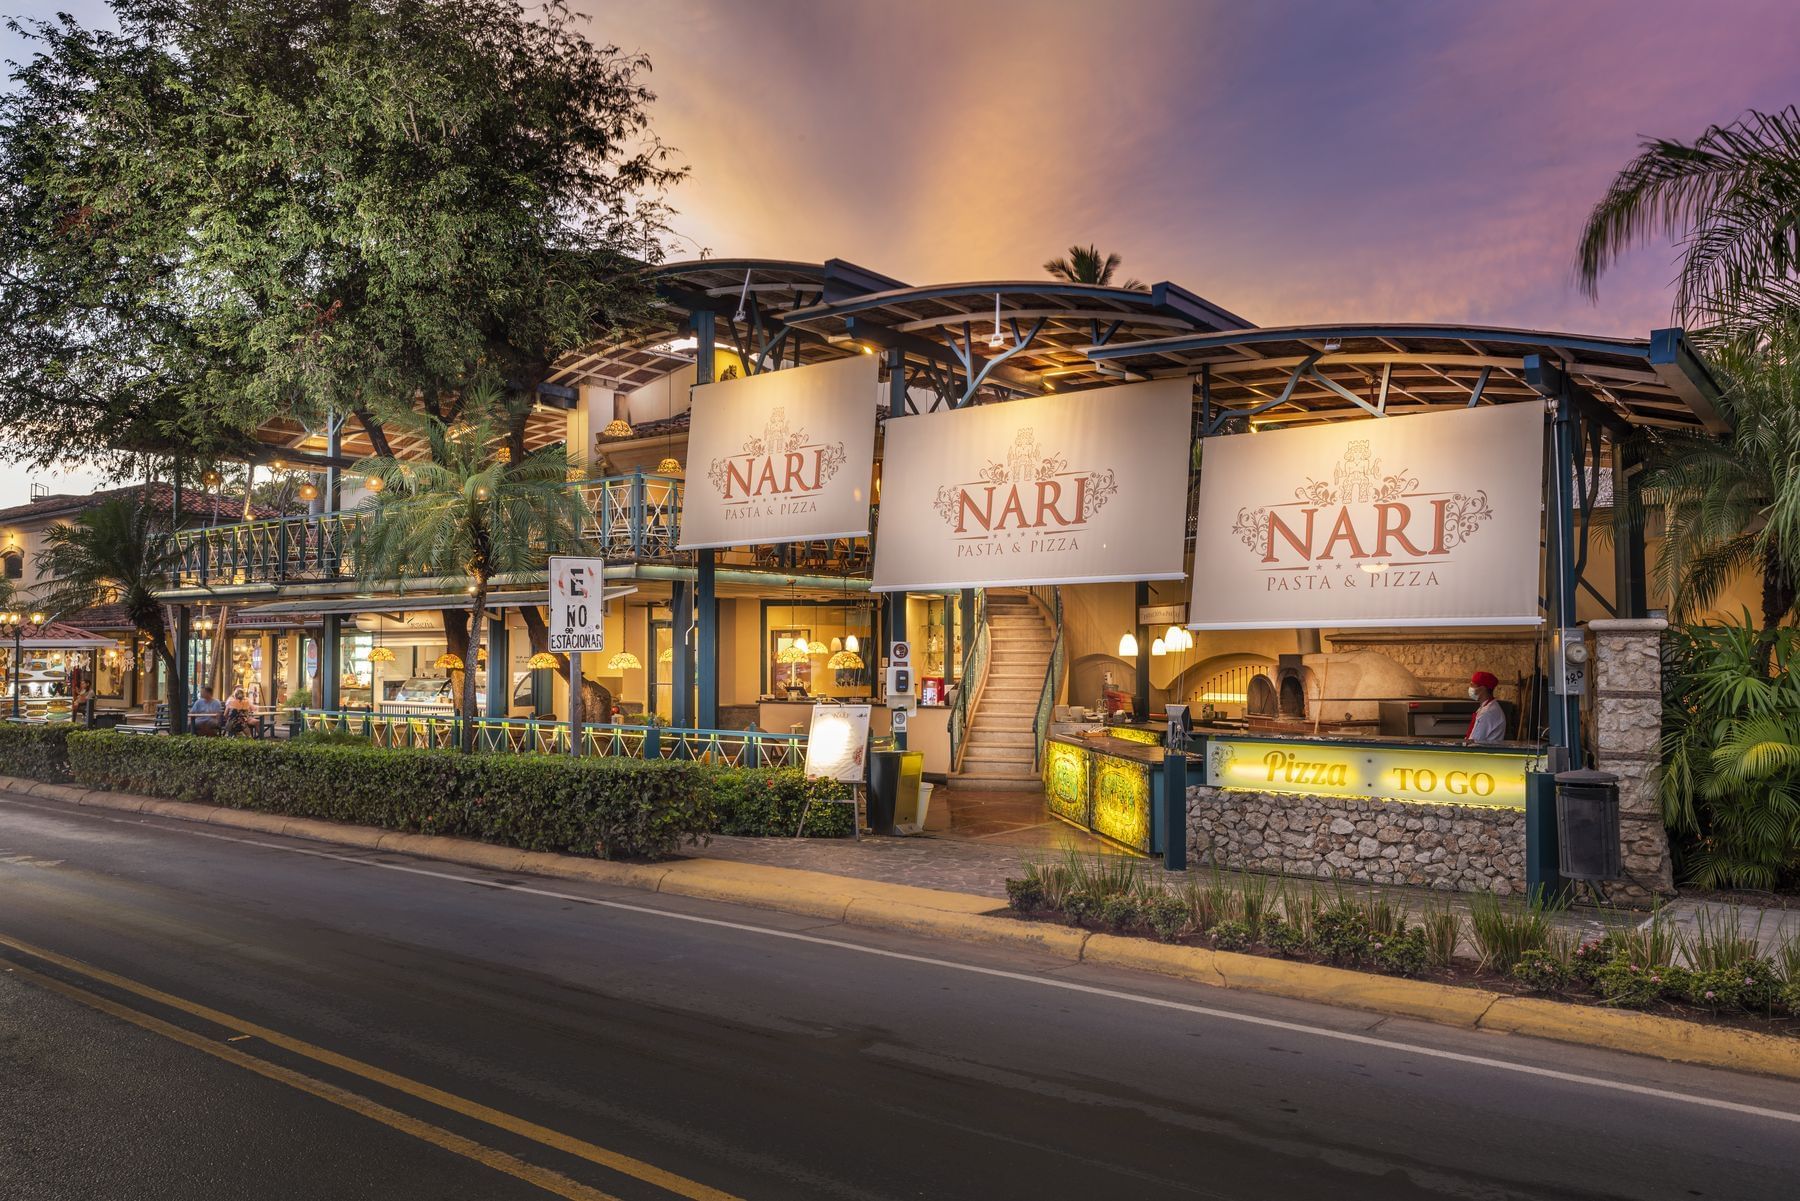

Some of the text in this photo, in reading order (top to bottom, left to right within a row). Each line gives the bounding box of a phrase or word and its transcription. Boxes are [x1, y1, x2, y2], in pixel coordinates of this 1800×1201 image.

[723, 449, 825, 499] NARI
[725, 501, 817, 520] PASTA & PIZZA
[954, 477, 1089, 533] NARI
[1261, 499, 1450, 563] NARI
[957, 537, 1079, 557] PASTA & PIZZA
[570, 569, 584, 596] E
[1267, 570, 1440, 591] PASTA & PIZZA
[567, 605, 587, 627] NO
[551, 634, 602, 649] ESTACIONAR
[1263, 750, 1495, 797] Pizza TO GO
